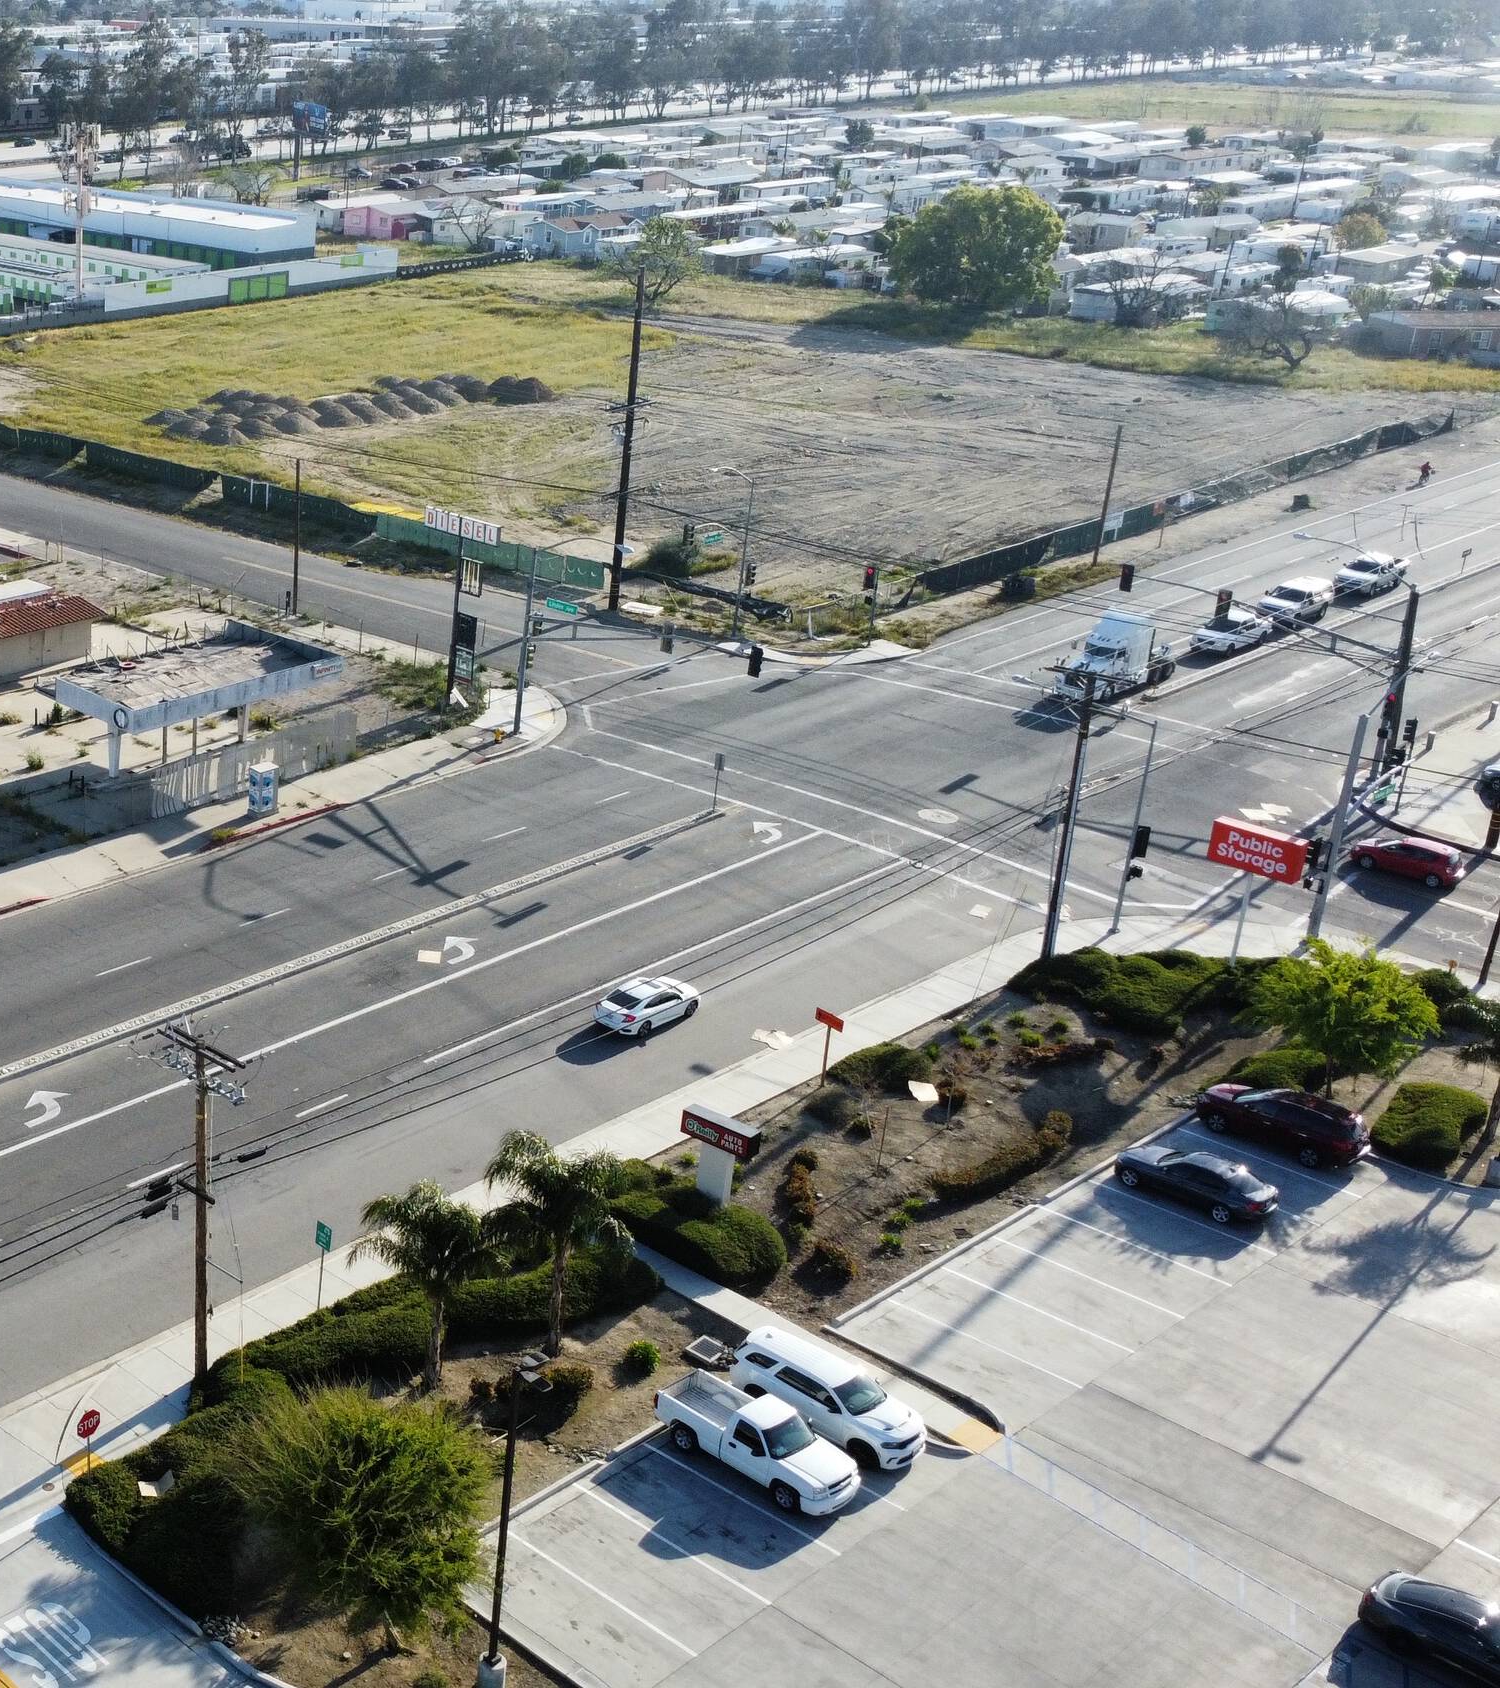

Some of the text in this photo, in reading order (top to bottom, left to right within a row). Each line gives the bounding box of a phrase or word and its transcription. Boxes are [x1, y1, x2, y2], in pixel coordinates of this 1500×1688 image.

[428, 512, 494, 542] DIESEL
[1216, 842, 1287, 874] Storage
[1227, 830, 1284, 858] Public
[686, 1118, 742, 1146] O'Reilly AUTO
[720, 1140, 744, 1154] PARTS
[78, 1415, 99, 1434] STOP
